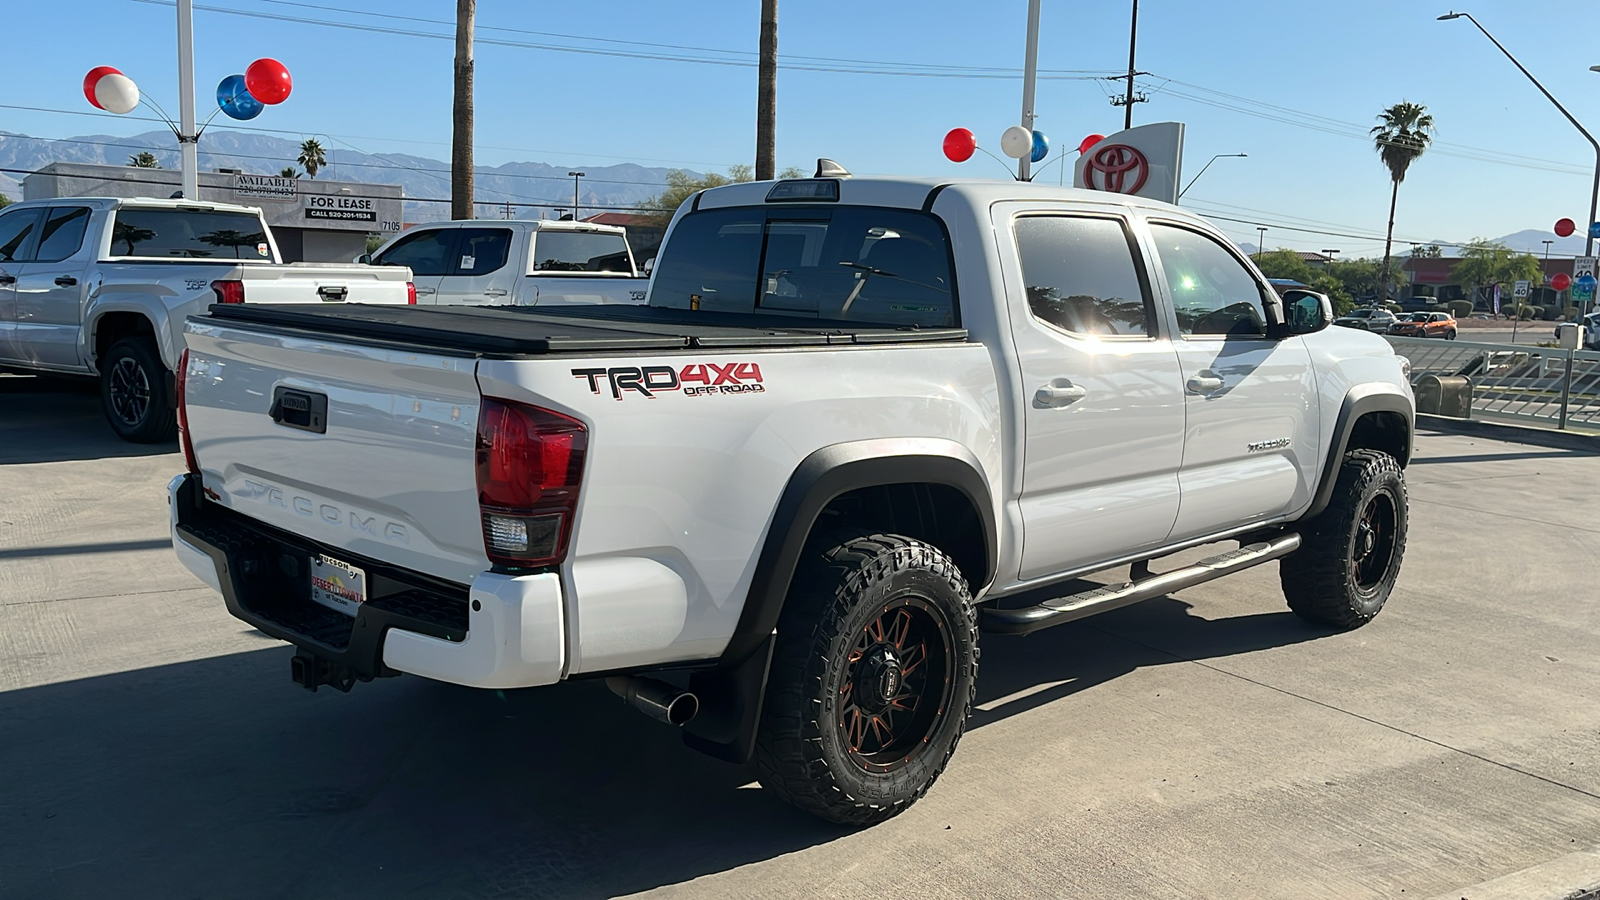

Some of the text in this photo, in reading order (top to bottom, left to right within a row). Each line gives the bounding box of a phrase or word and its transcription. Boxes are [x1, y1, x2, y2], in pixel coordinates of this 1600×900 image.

[237, 176, 296, 187] AVAILABLE
[310, 197, 371, 210] FOR LEASE
[382, 221, 400, 231] 7105
[571, 366, 681, 401] TRD
[683, 383, 766, 397] OFF ROAD
[244, 479, 411, 545] TACOMA
[319, 555, 349, 569] TUCSON
